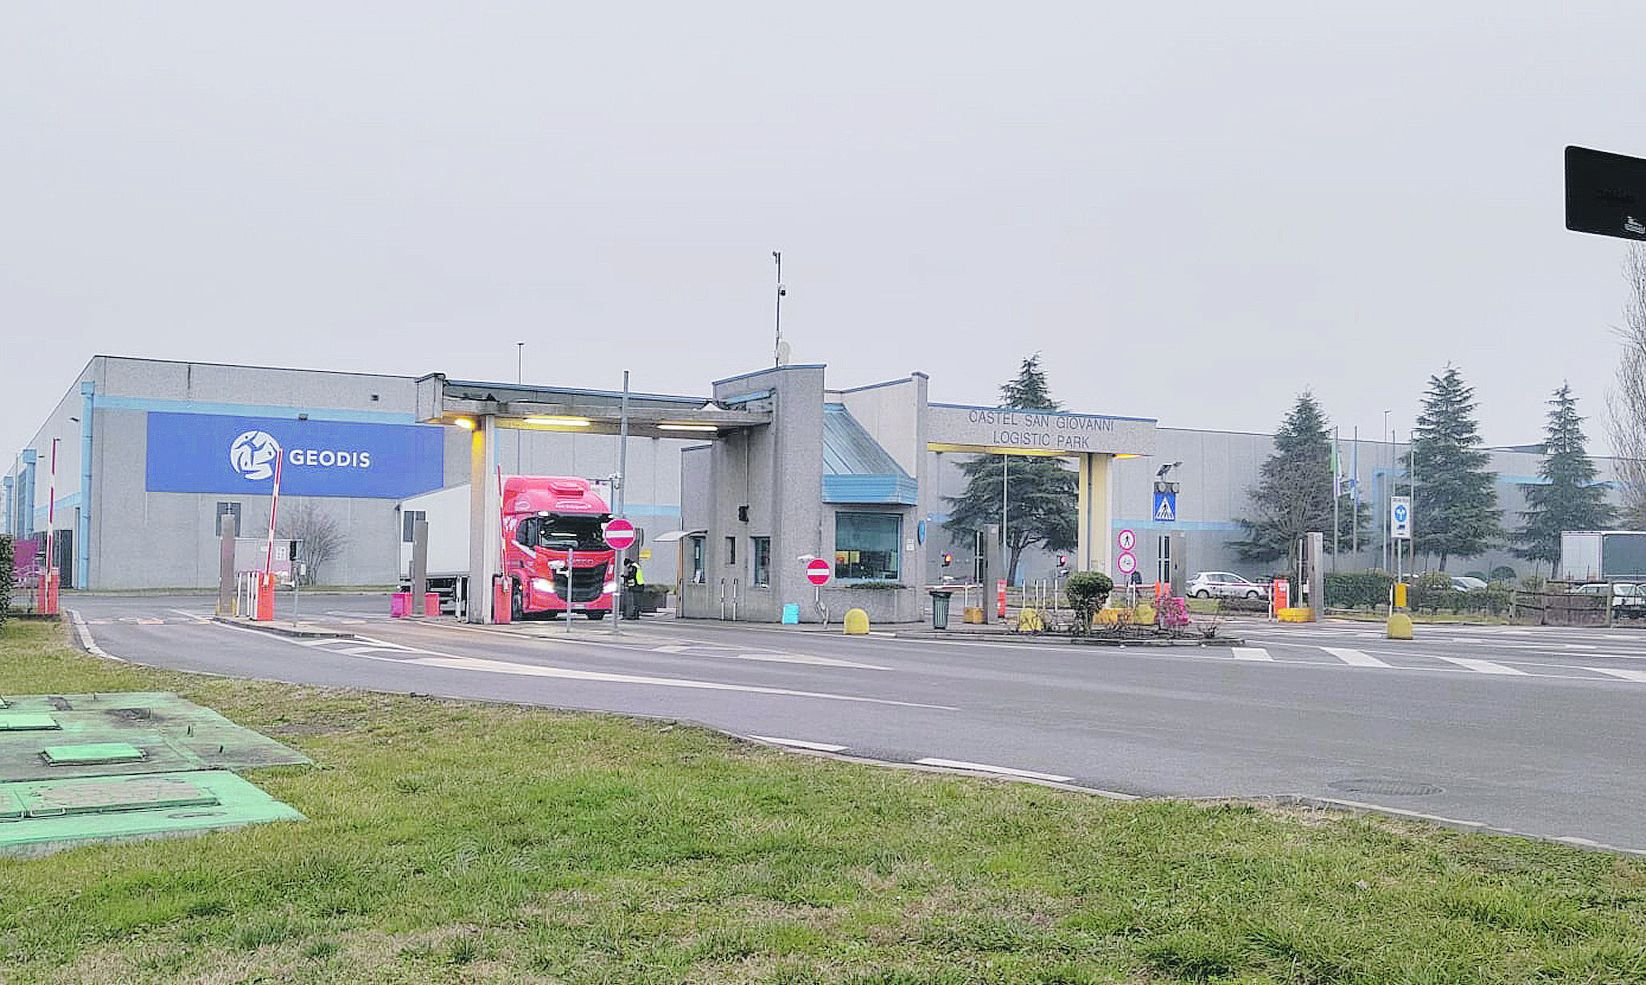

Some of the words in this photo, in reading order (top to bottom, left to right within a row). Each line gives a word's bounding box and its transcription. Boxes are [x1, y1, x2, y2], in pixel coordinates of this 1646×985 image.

[969, 410, 1018, 426] CASTEL
[1025, 414, 1050, 428] SAN
[1056, 416, 1114, 431] GIOVANNI
[993, 430, 1051, 446] LOGISTIC
[1057, 434, 1090, 449] PARK
[289, 449, 371, 468] GEODIS
